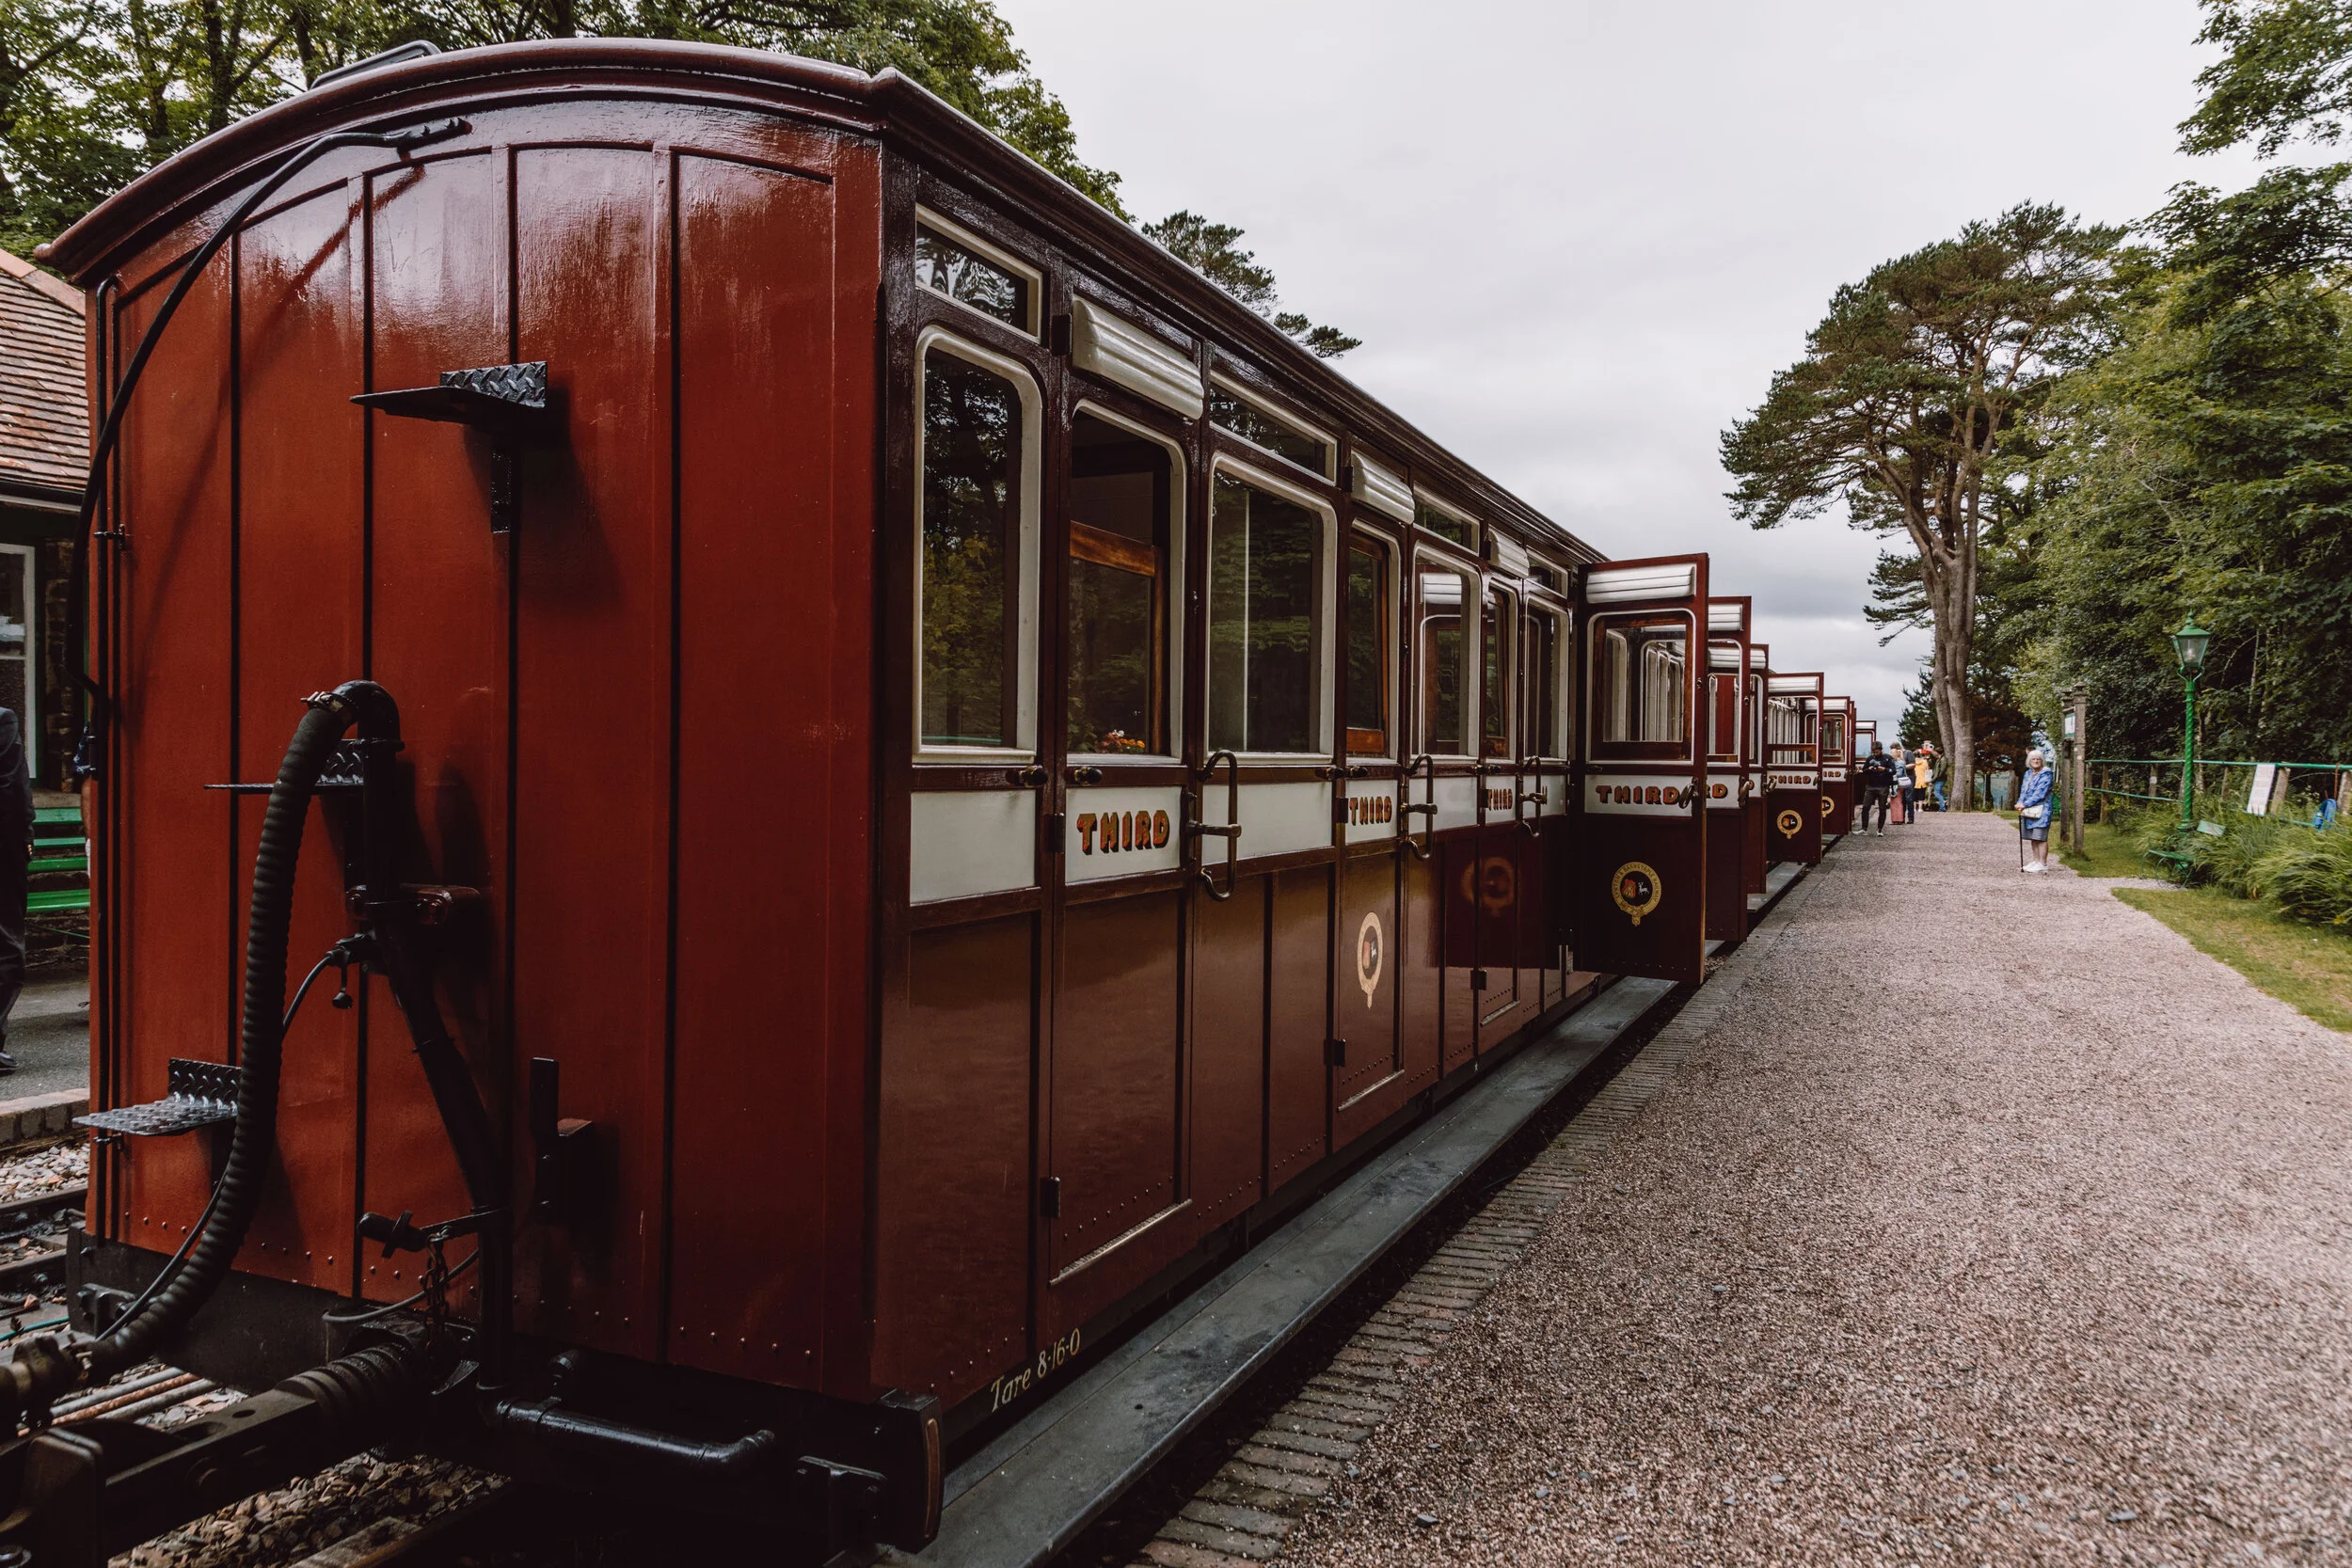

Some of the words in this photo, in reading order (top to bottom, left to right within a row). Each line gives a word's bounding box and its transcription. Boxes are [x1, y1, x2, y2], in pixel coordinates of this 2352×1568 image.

[1349, 796, 1392, 826] THIRD
[1596, 785, 1679, 805] THIRD
[1076, 810, 1170, 855] THIRD
[991, 1368, 1031, 1413] Tare
